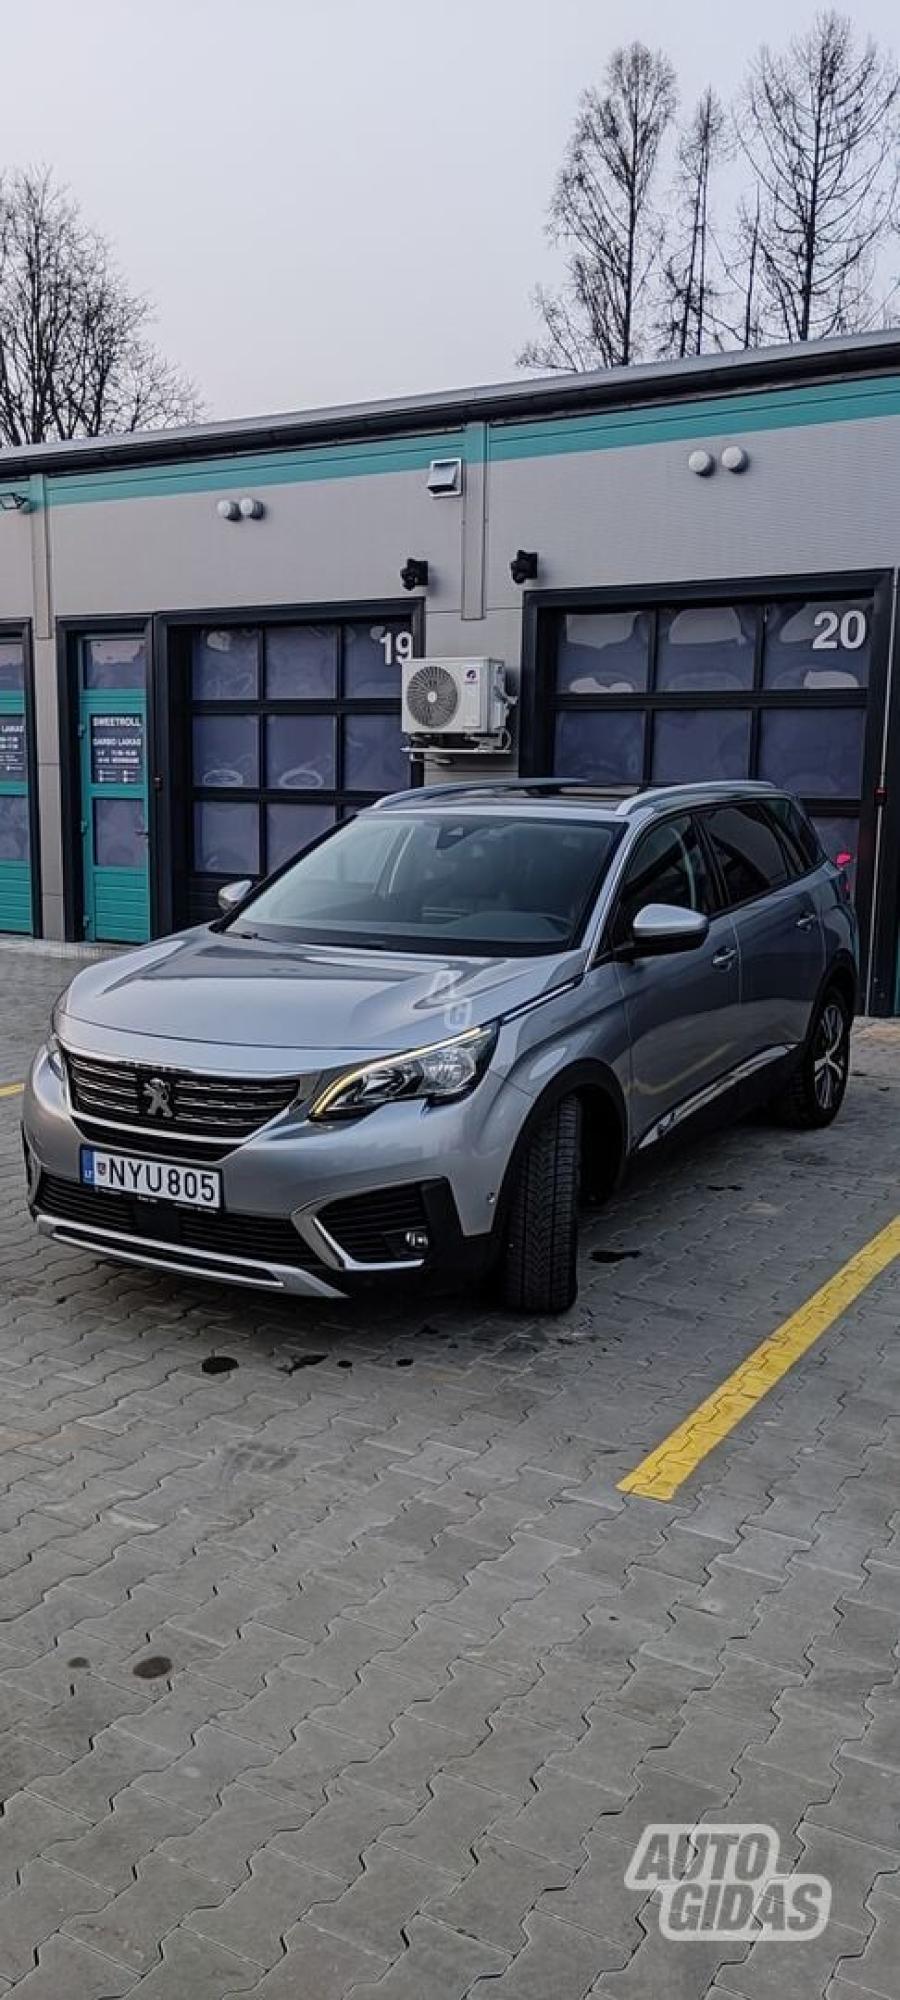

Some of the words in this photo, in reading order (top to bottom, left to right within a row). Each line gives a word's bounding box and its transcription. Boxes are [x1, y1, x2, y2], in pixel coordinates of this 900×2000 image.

[380, 632, 412, 665] 19
[813, 611, 866, 649] 20
[109, 1158, 214, 1202] NYU805
